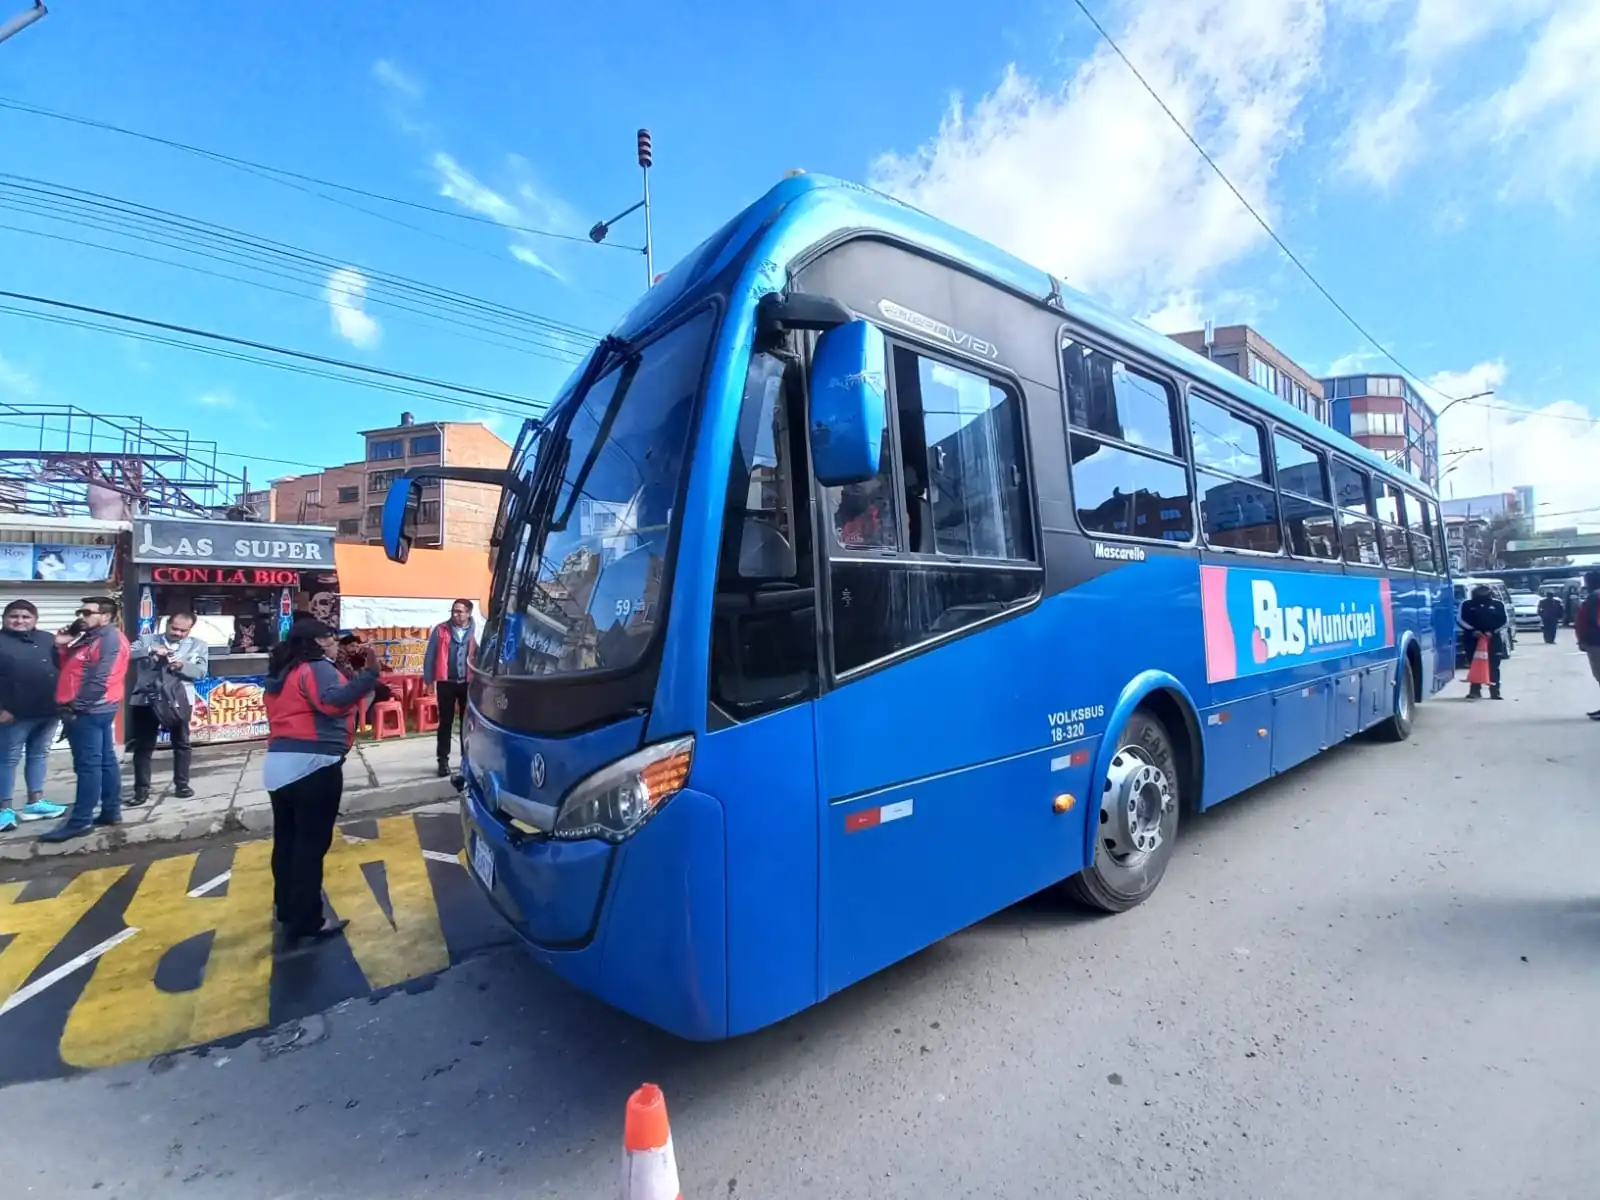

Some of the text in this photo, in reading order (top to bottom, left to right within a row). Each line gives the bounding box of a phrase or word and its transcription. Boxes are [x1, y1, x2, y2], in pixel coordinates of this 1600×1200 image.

[234, 539, 322, 560] SUPER
[1095, 542, 1145, 561] Mascarello
[153, 567, 208, 583] CON
[216, 569, 248, 584] LA
[615, 599, 630, 616] 59
[1306, 602, 1376, 647] Municipal
[1047, 704, 1105, 727] VOLKSBUS
[1051, 722, 1085, 743] 18-320
